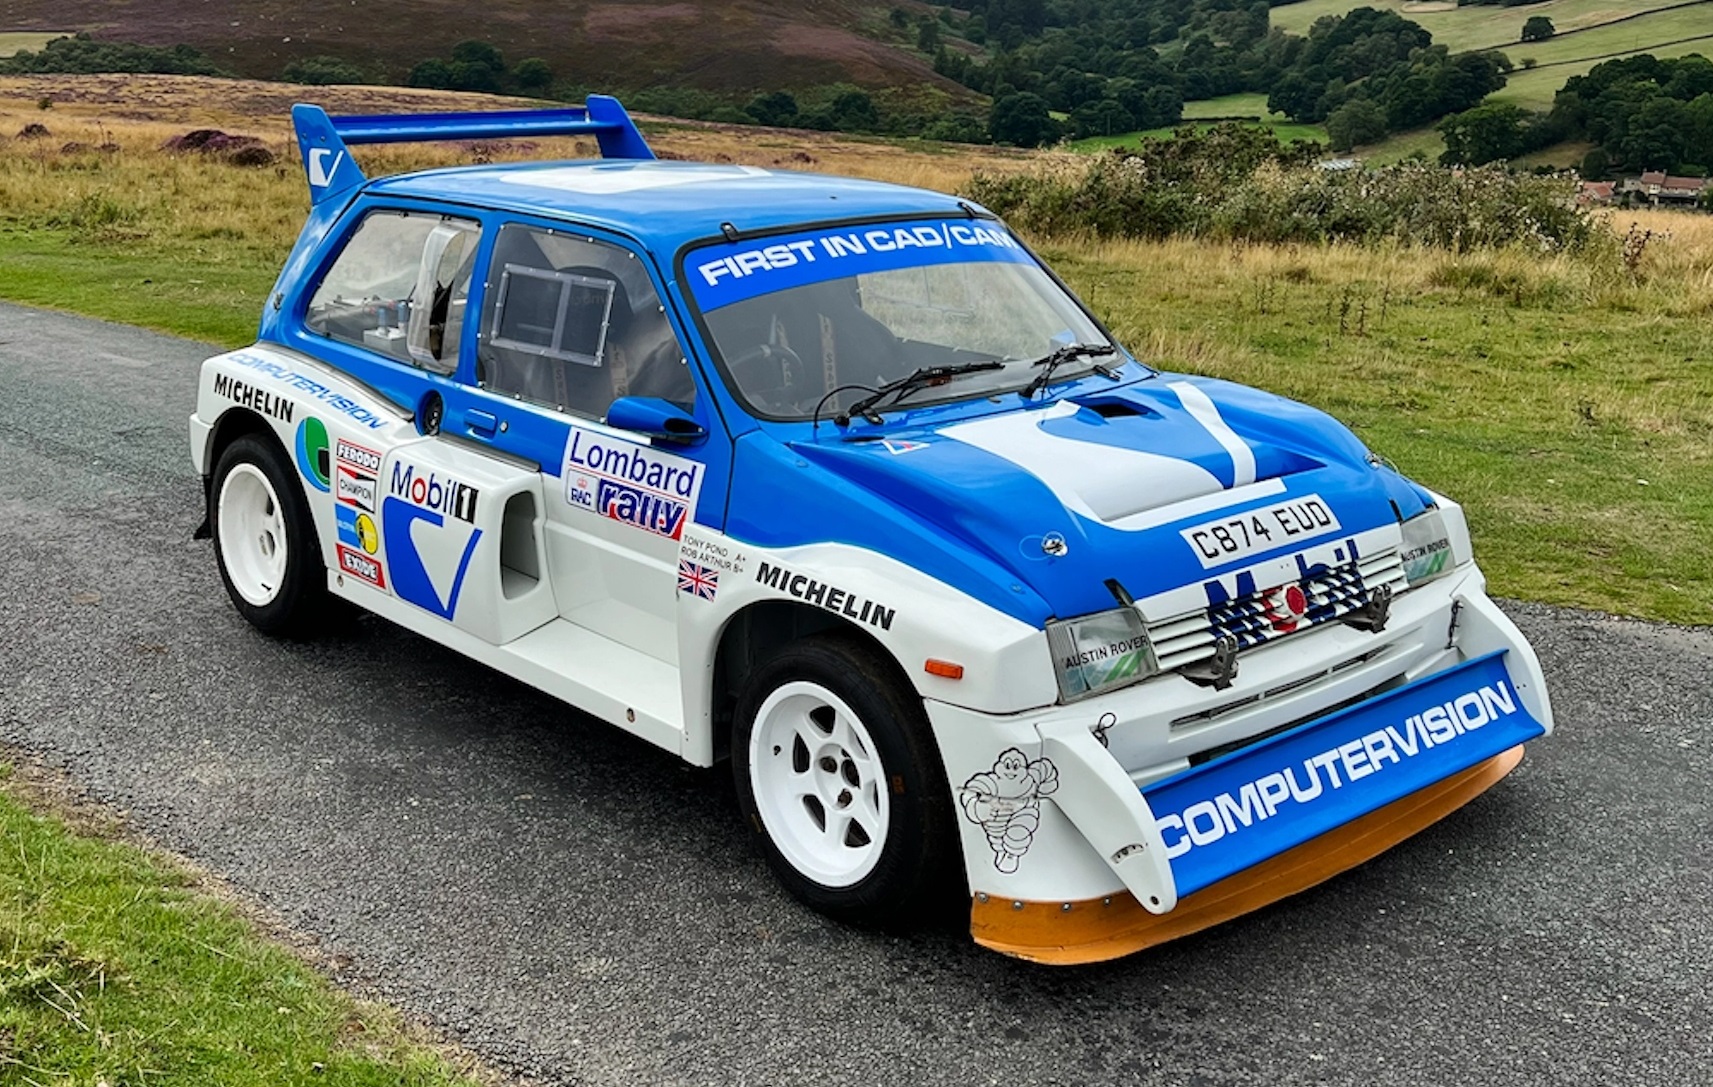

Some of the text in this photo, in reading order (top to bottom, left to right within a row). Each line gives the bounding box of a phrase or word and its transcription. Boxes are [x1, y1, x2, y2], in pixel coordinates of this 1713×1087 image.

[698, 222, 1020, 287] FIRST IN CAD/CAM
[213, 372, 296, 424] MICHELIN
[226, 352, 389, 430] COMPUTERVISION
[337, 442, 381, 471] FERODO
[569, 430, 697, 498] Lombard
[339, 478, 373, 502] CHAMPION
[571, 487, 591, 507] RAC
[601, 484, 686, 537] rally
[684, 534, 704, 548] TONY
[705, 542, 729, 557] POND
[1192, 501, 1332, 559] C874 EUD
[343, 552, 378, 581] EXIDE
[681, 546, 698, 559] ROB
[698, 553, 732, 571] ARTHUR
[755, 560, 897, 632] MICHELIN
[1065, 634, 1148, 669] AUSTIN ROVER
[1157, 680, 1517, 859] COMPUTERVISION
